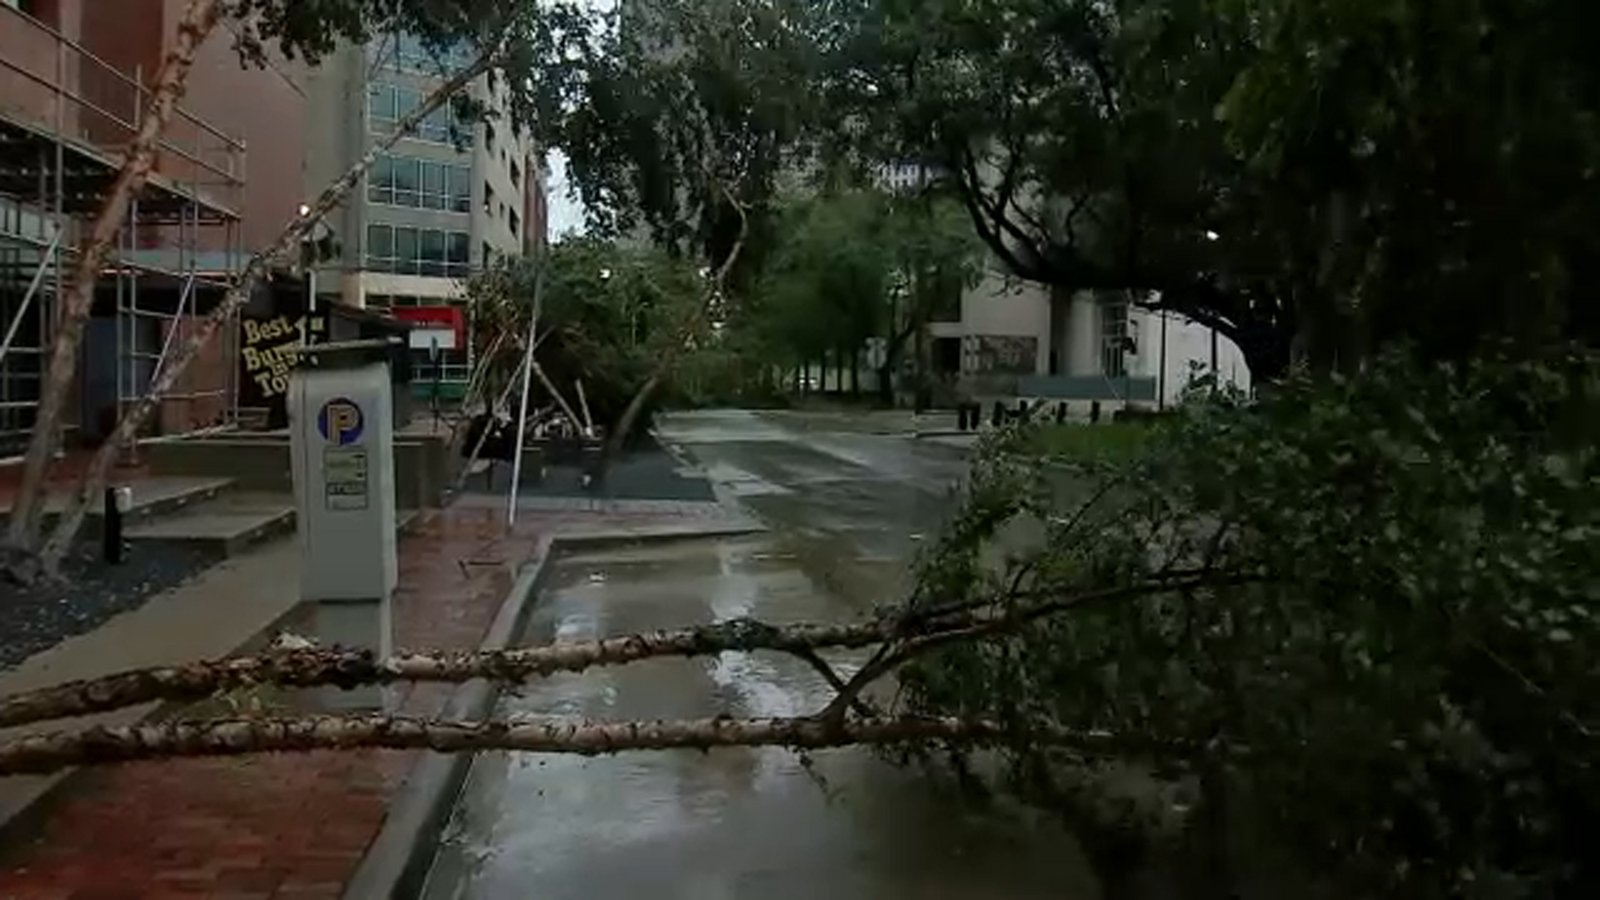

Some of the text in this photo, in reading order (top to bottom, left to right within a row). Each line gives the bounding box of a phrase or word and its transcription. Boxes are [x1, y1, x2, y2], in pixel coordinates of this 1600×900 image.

[243, 315, 294, 345] Best
[254, 371, 290, 398] To
[326, 404, 359, 445] P
